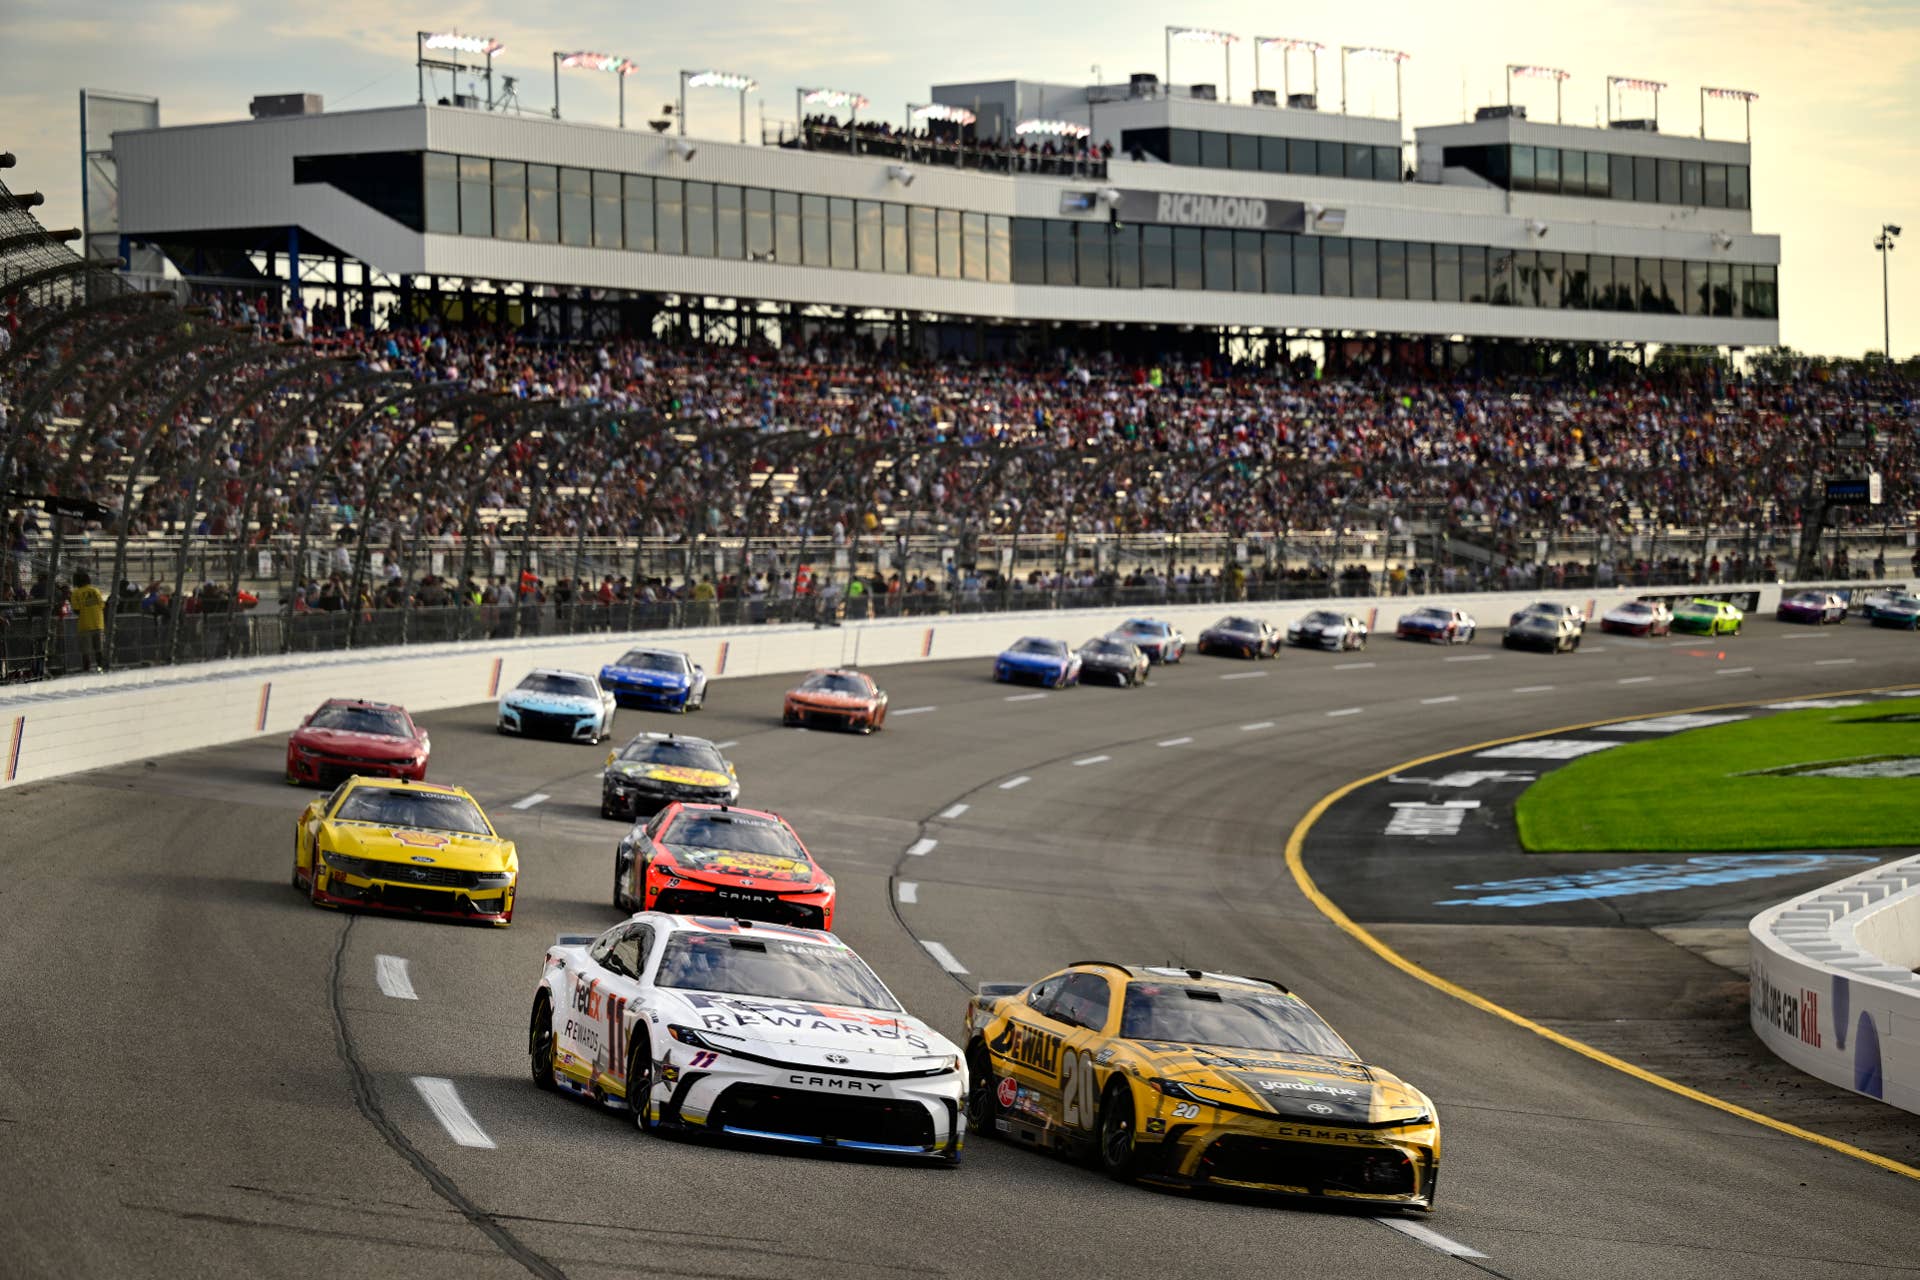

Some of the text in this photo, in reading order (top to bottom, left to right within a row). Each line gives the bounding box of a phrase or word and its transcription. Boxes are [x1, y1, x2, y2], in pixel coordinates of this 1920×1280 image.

[1157, 191, 1267, 226] RICHMOND
[420, 792, 462, 802] LOGANO
[665, 878, 681, 888] 19
[719, 891, 775, 903] CAMRY
[572, 972, 602, 1022] FedEx
[1783, 993, 1798, 1039] can
[1801, 988, 1821, 1048] kill.
[564, 1019, 599, 1053] REWARDS
[606, 992, 628, 1079] 11
[701, 1013, 929, 1050] REWARDS
[688, 1050, 719, 1069] 11
[790, 1074, 882, 1092] CAMRY
[1062, 1045, 1095, 1131] 20
[1258, 1079, 1358, 1097] yardnique
[1170, 1101, 1200, 1119] 20
[1278, 1127, 1368, 1142] CAMRY
